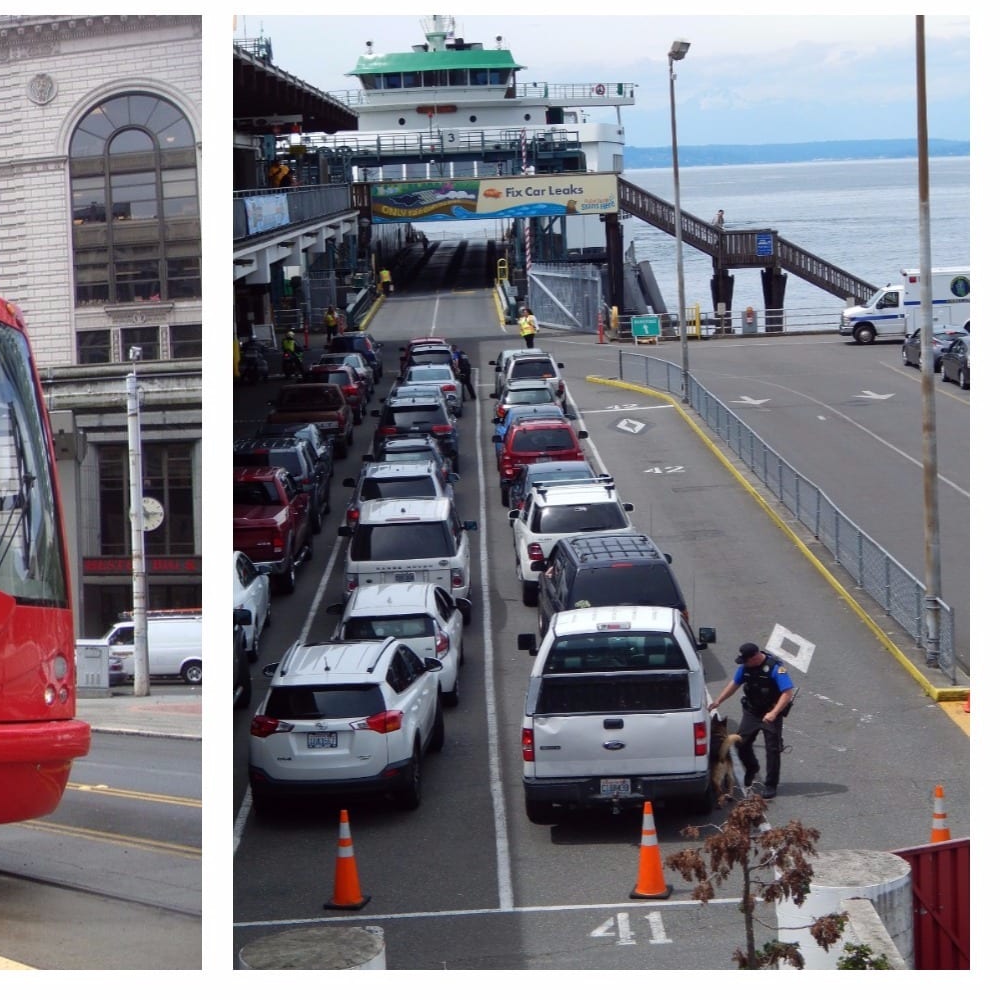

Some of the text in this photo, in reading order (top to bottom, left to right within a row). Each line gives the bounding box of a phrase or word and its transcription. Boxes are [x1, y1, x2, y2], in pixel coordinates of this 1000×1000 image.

[447, 133, 455, 143] 3
[505, 184, 584, 198] Fix Car Leaks
[643, 465, 686, 474] 42
[589, 911, 673, 946] 41
